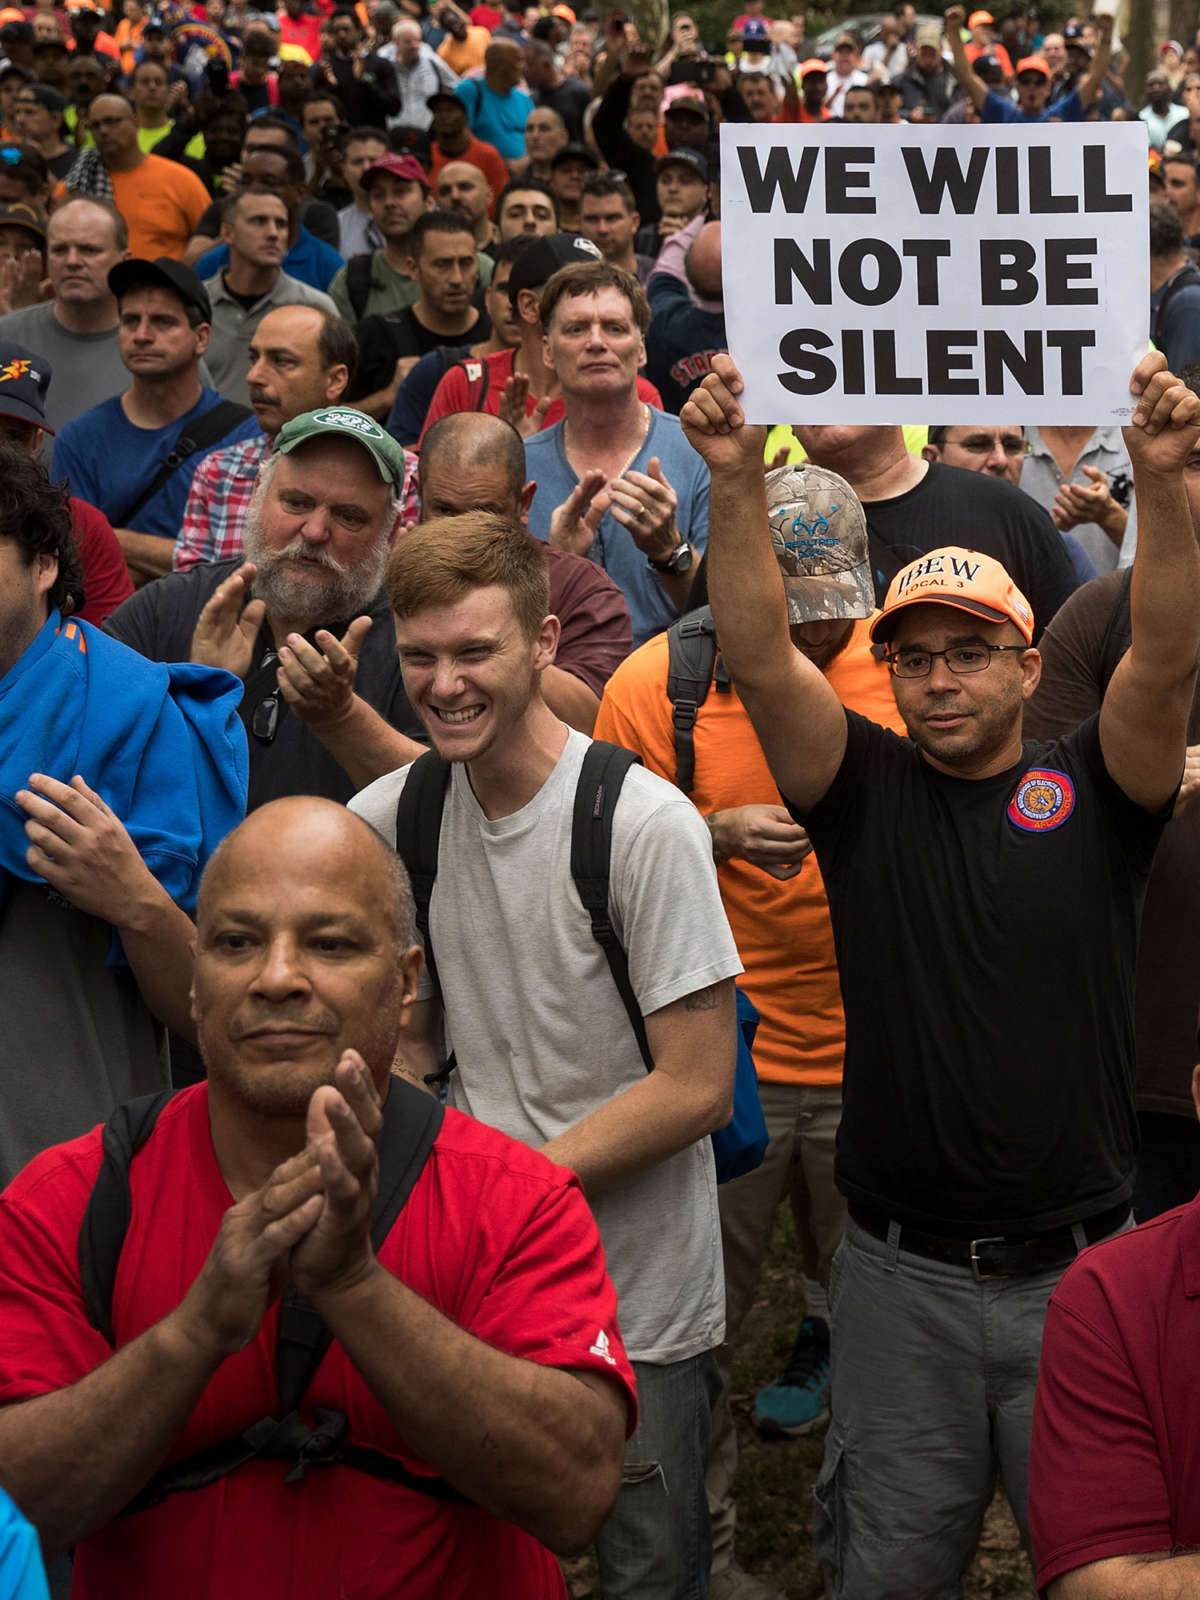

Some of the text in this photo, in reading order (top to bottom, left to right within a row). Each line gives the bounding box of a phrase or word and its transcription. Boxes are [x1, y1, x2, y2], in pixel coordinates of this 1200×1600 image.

[736, 145, 1133, 215] WE WILL
[774, 238, 1099, 306] NOT BE
[777, 328, 1096, 396] SILENT
[897, 555, 982, 597] IBEW
[905, 578, 965, 596] LOCAL 3
